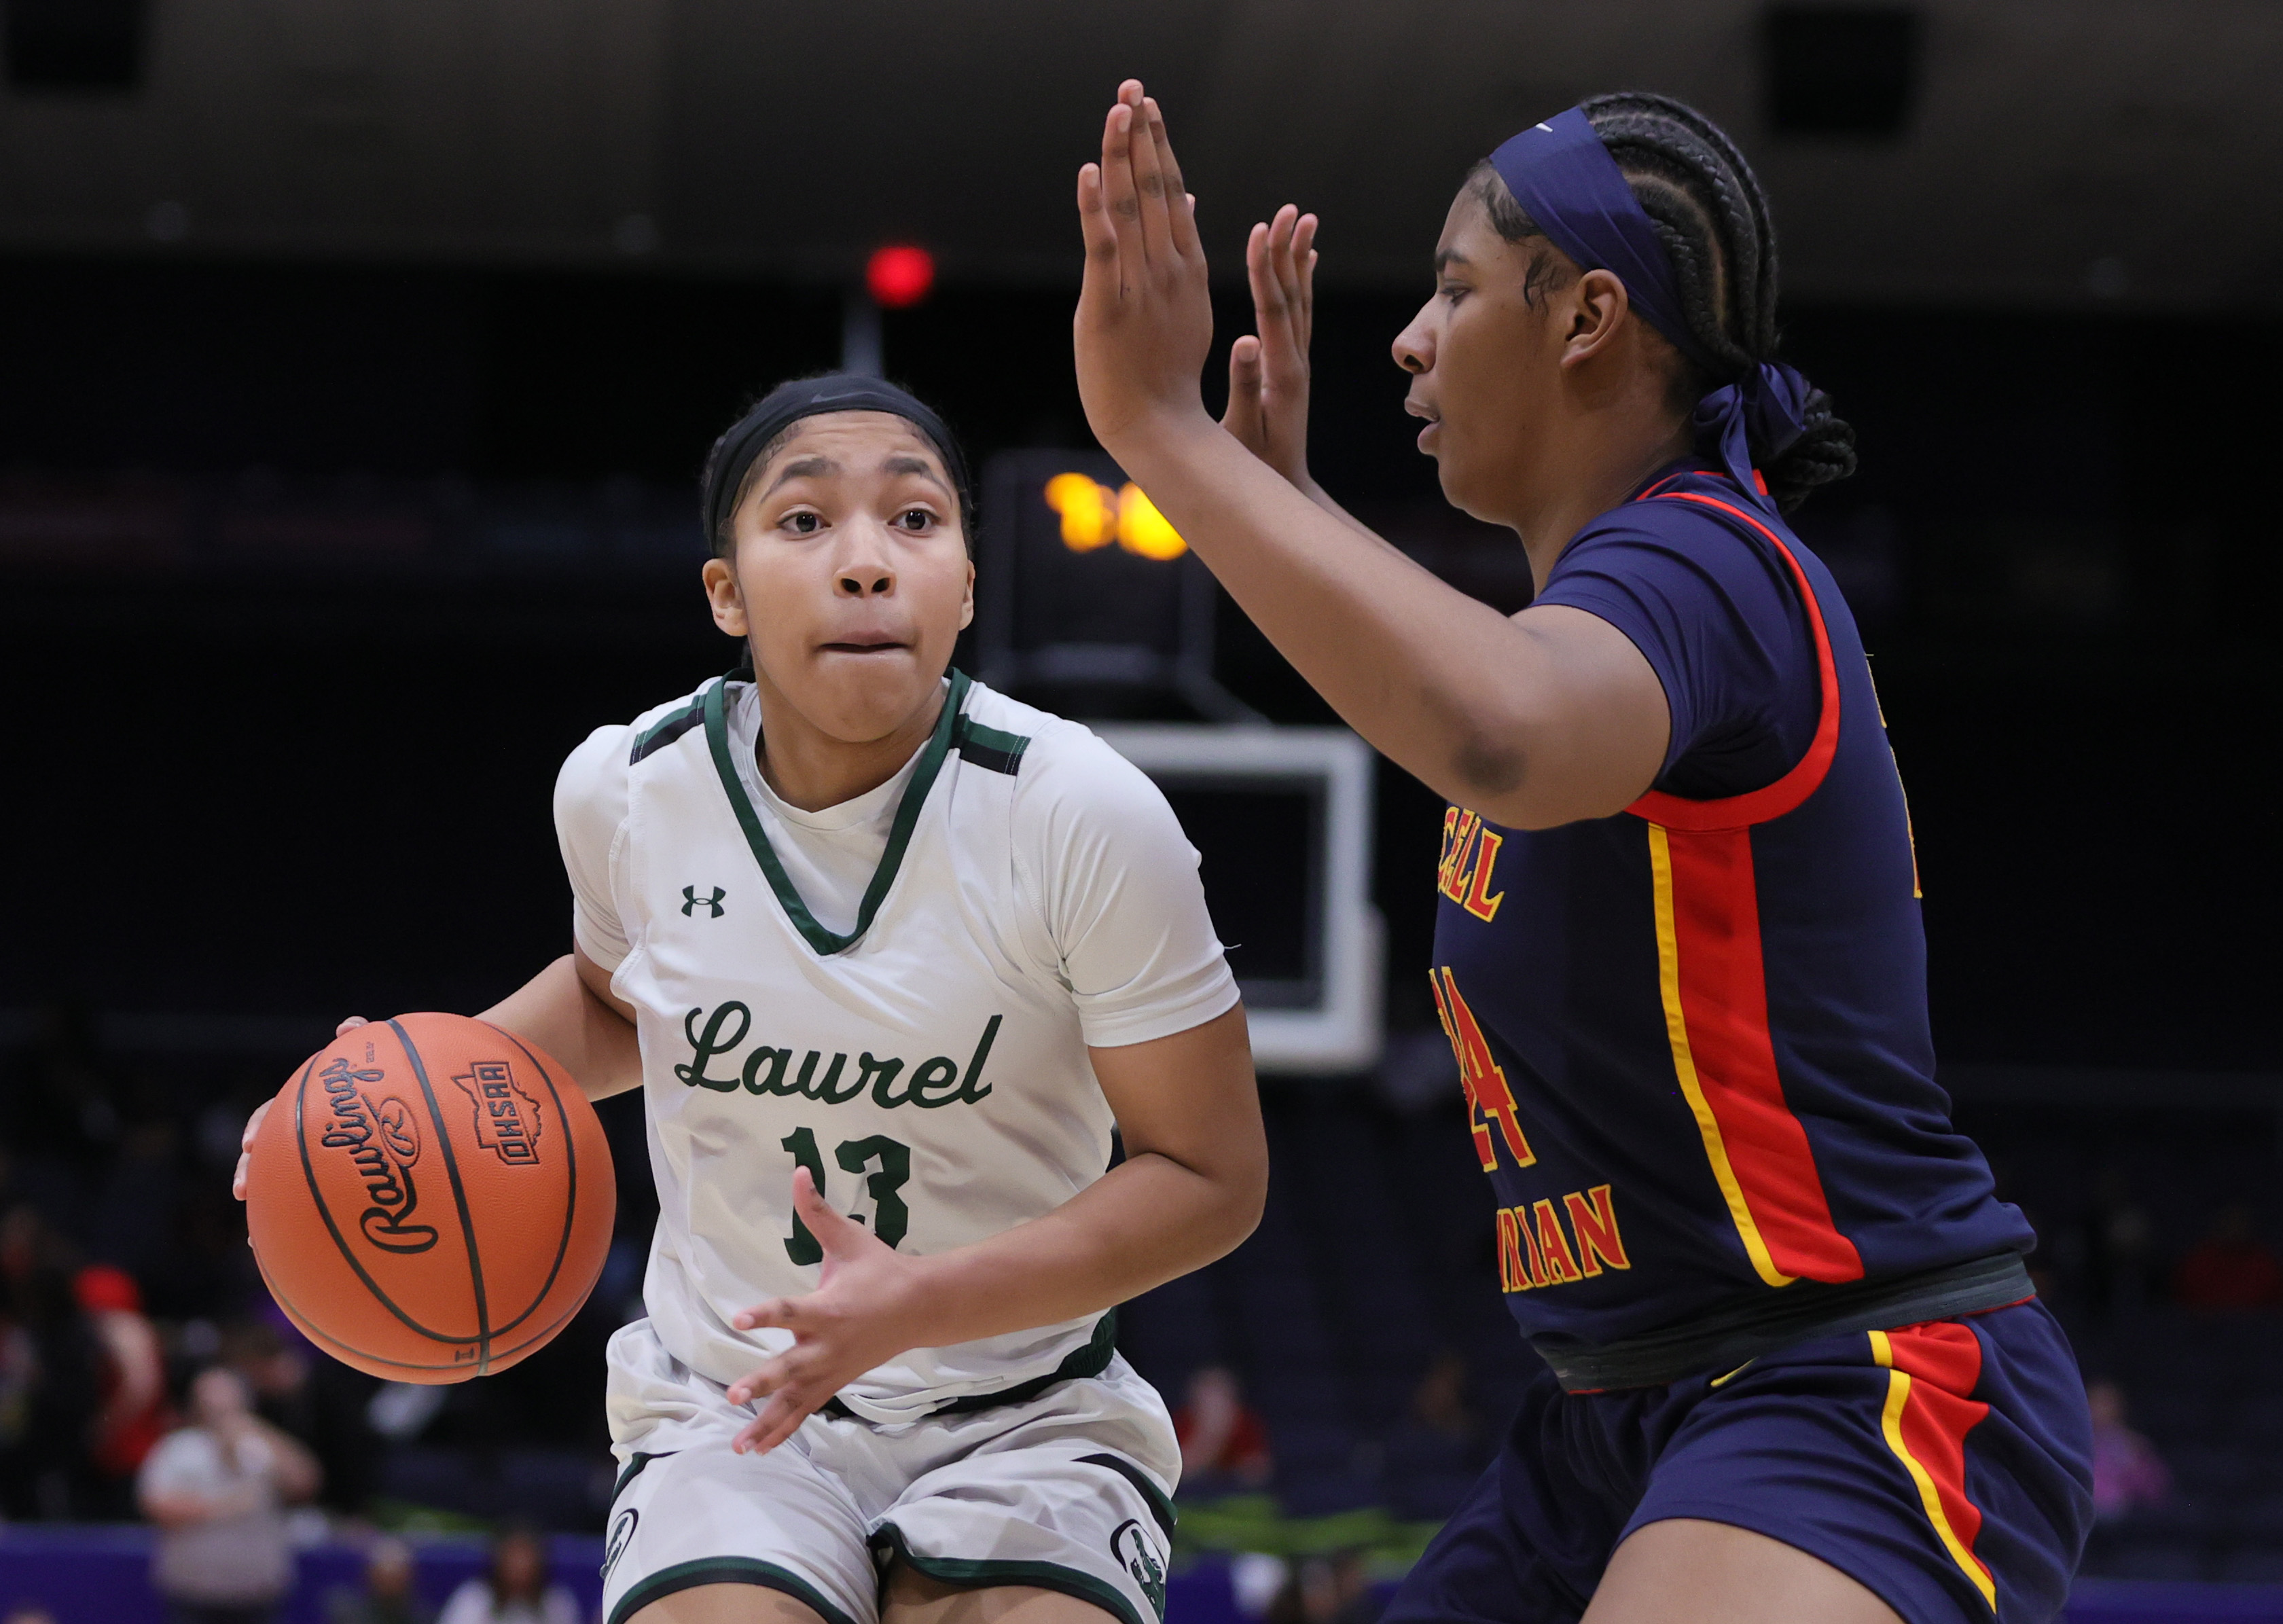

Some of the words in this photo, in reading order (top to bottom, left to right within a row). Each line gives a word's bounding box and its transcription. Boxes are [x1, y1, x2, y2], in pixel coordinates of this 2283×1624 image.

[479, 1067, 530, 1157] OHSAA
[675, 1000, 1003, 1108] Laurel
[319, 1058, 438, 1254] Rawlings
[780, 1126, 910, 1265] 13
